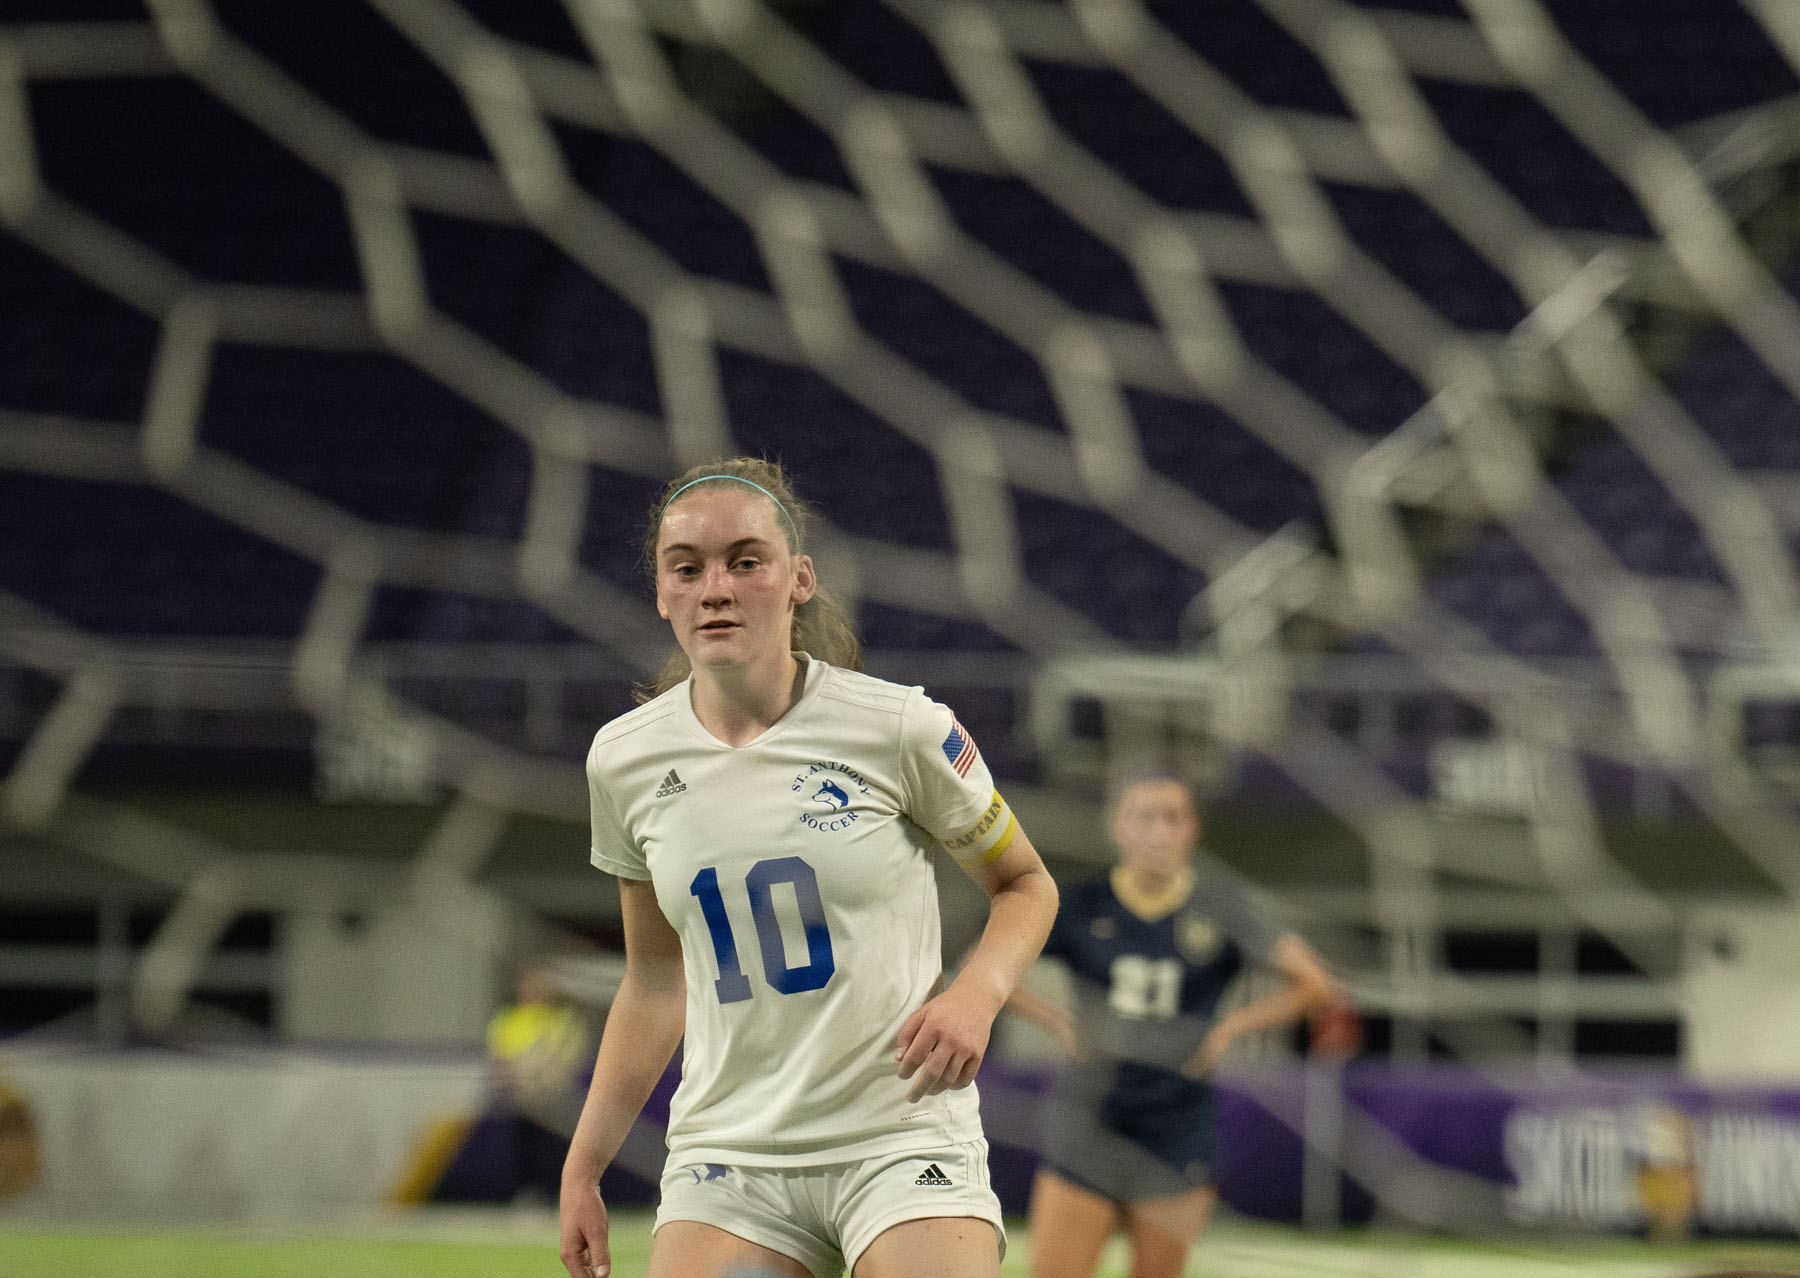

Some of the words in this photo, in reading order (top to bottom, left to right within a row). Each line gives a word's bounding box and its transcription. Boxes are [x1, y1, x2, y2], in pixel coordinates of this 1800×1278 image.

[656, 782, 687, 798] adidas
[791, 773, 809, 794] ST.
[808, 761, 871, 797] ANTHONY
[799, 810, 859, 833] SOCCER
[944, 798, 1002, 849] CAPTAIN
[690, 856, 835, 1004] 10
[914, 1177, 953, 1186] adidas
